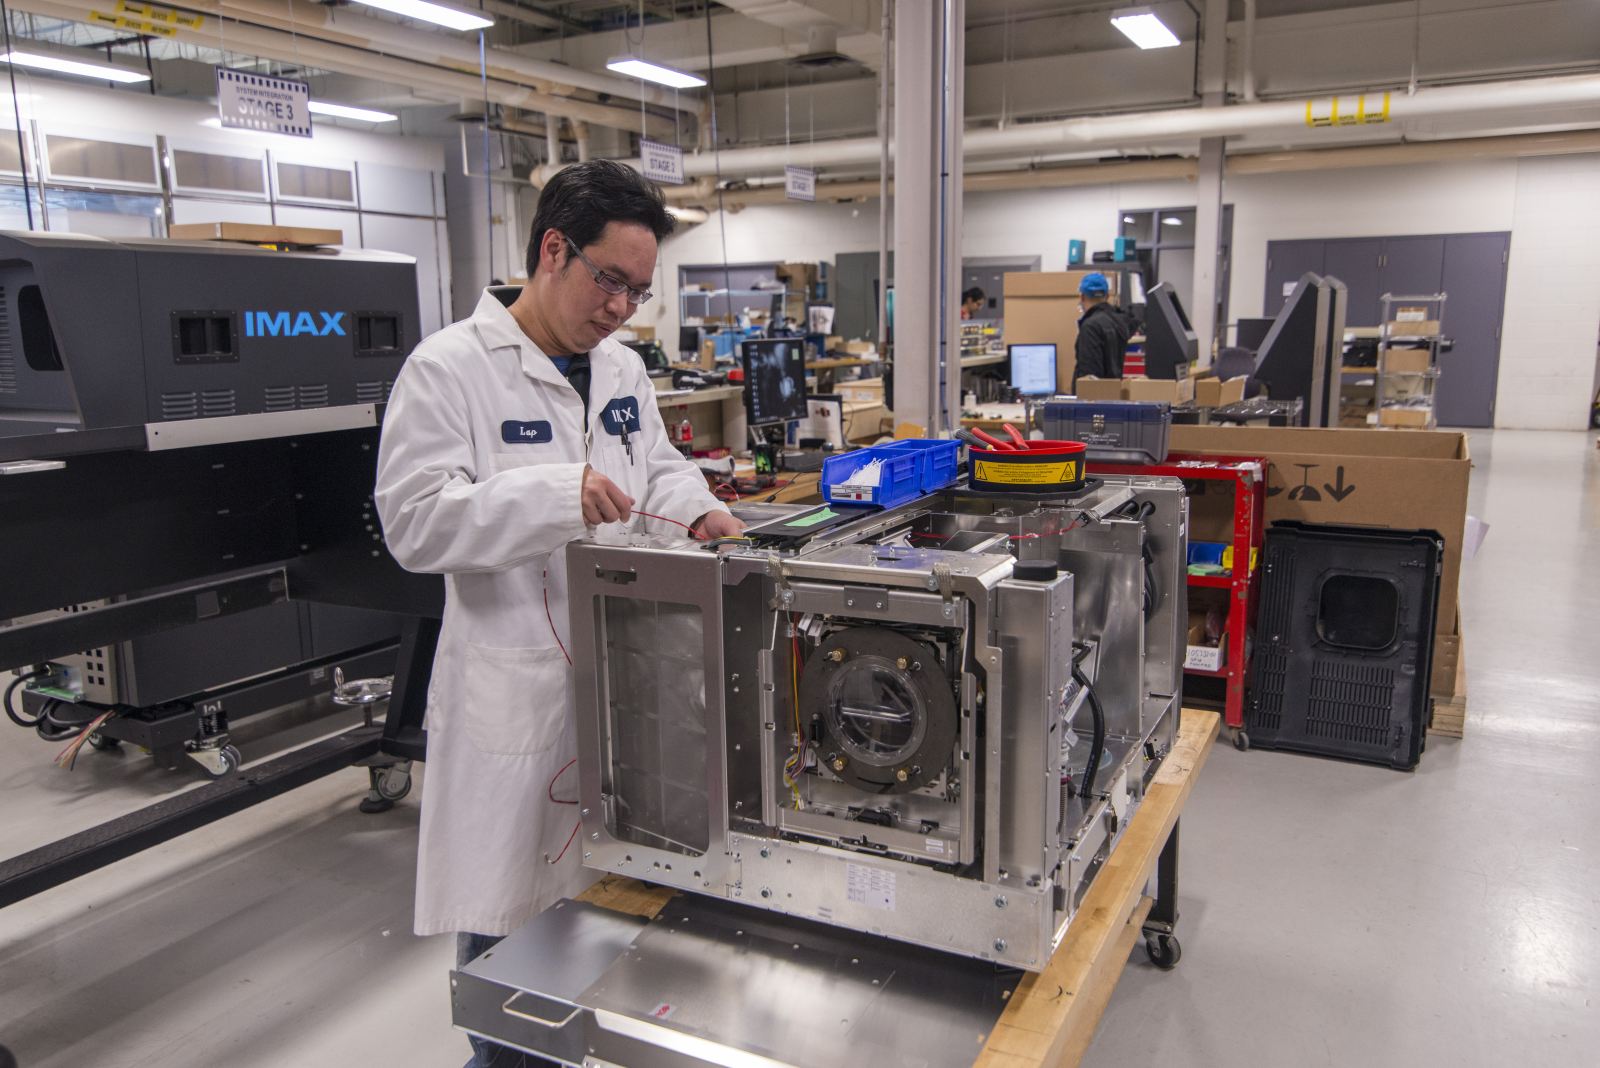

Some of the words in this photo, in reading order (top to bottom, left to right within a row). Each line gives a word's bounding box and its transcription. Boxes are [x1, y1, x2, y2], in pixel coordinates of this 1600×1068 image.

[236, 86, 258, 97] SYSTEM
[258, 90, 294, 101] INTEGRATION
[238, 97, 284, 119] STAGE
[286, 104, 294, 120] 3
[650, 158, 670, 173] STAGE
[245, 311, 347, 337] IMAX
[520, 426, 537, 438] Lap
